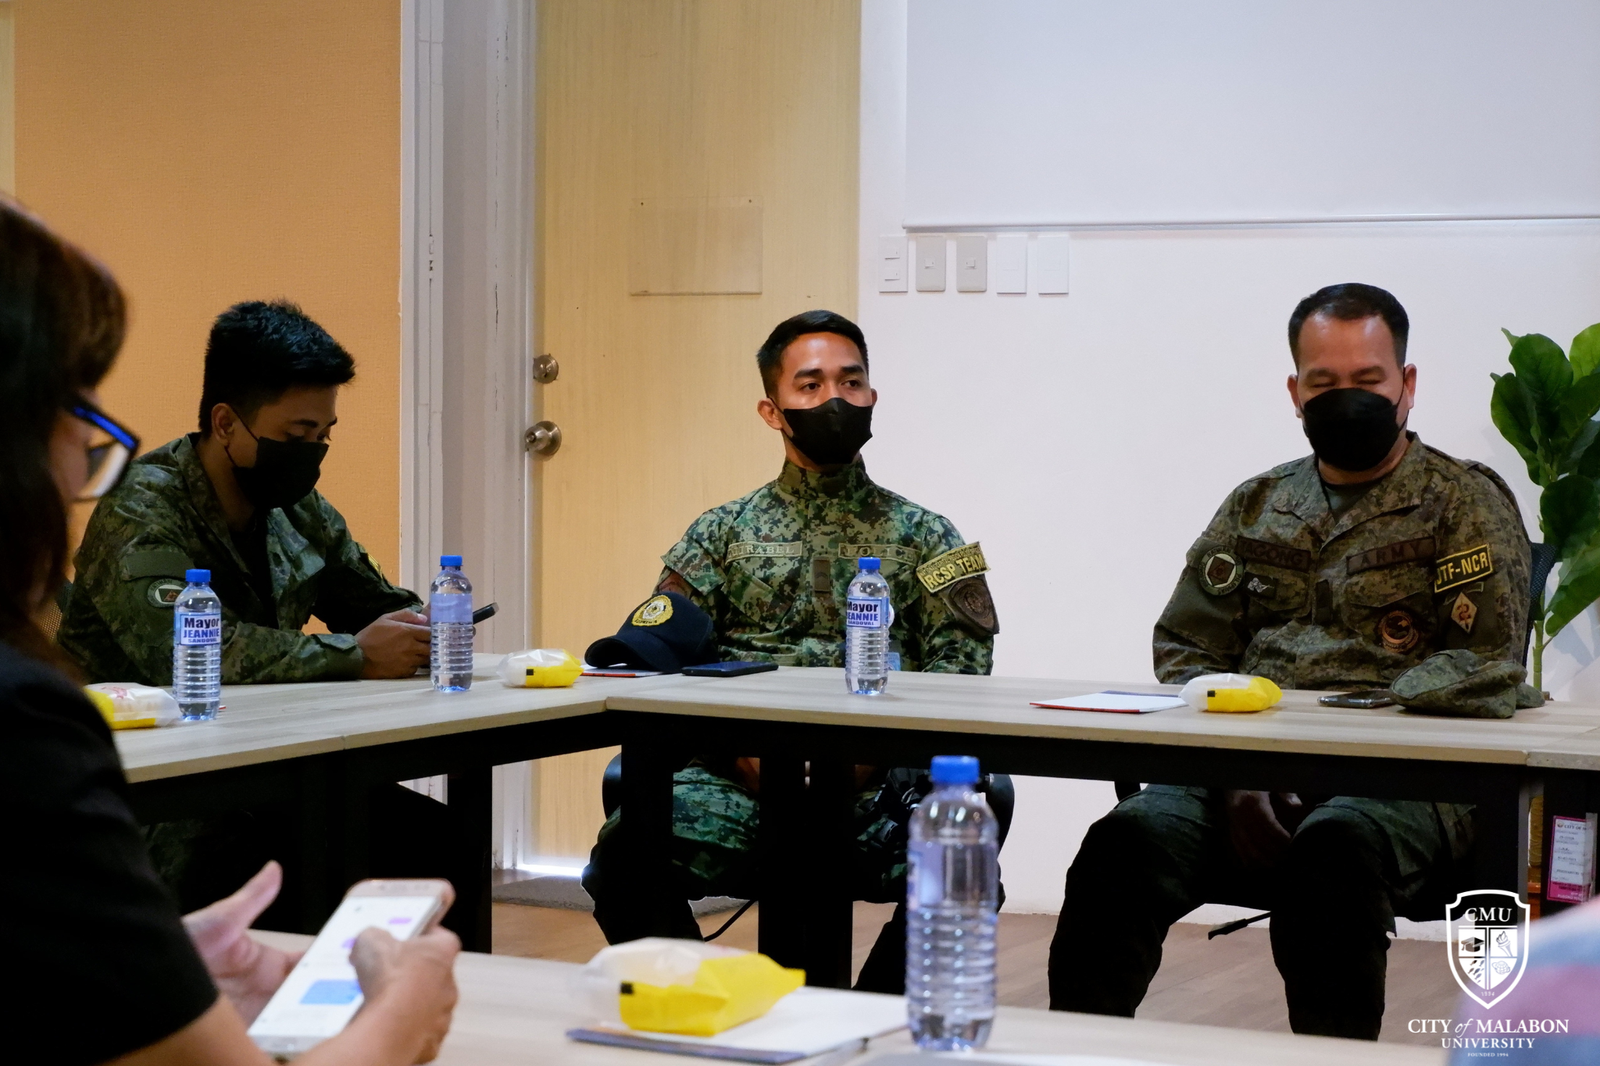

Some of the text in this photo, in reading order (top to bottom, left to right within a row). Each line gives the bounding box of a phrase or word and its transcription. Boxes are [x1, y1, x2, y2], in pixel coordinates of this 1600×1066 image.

[845, 546, 915, 561] POLICE
[1360, 541, 1422, 567] ARMY
[924, 563, 956, 588] RCSP
[955, 553, 986, 573] TEAM
[1436, 552, 1489, 585] JTF-NCR
[184, 617, 219, 629] Mayor
[847, 612, 879, 621] EANNIE
[183, 628, 219, 638] JEANNIE
